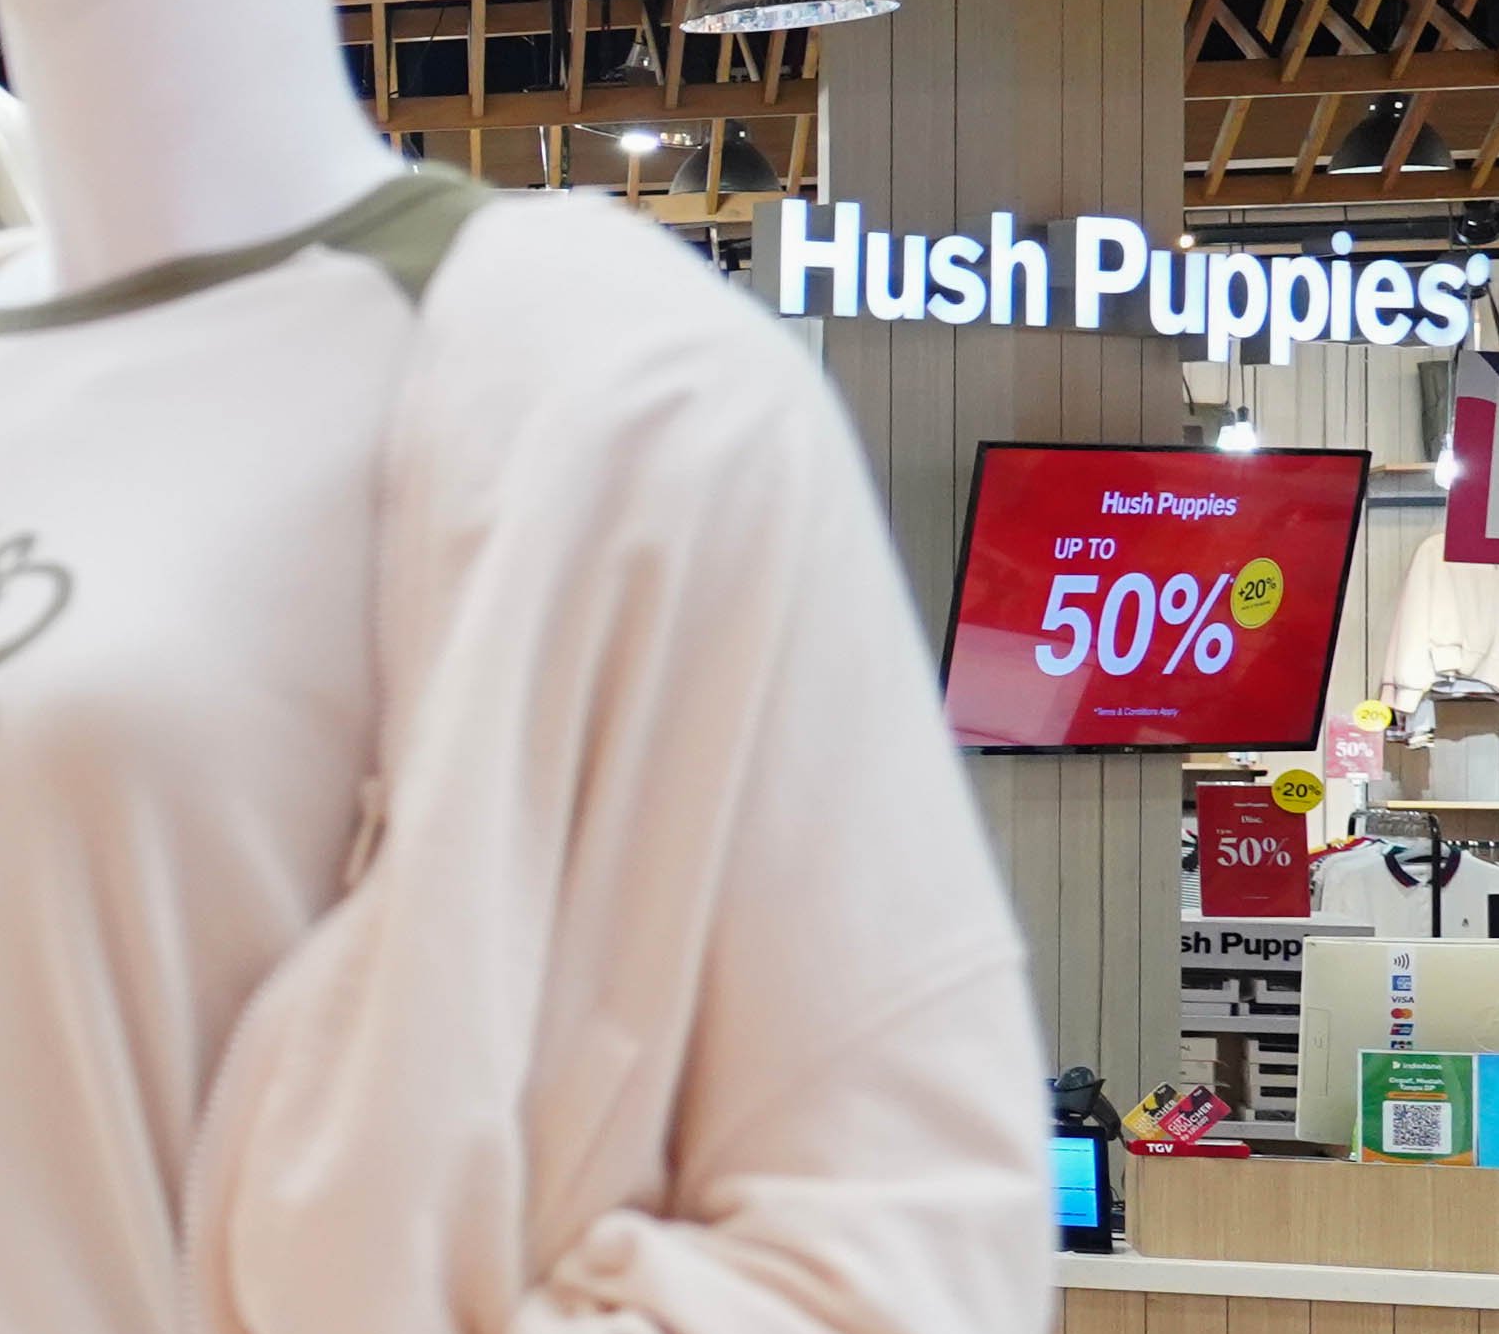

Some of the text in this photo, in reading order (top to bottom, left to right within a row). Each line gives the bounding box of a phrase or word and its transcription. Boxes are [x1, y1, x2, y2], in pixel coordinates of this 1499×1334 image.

[778, 198, 1470, 366] Hush Puppies
[1102, 492, 1237, 521] Hush Puppies
[1054, 537, 1116, 560] UP TO
[1238, 577, 1277, 601] +20%
[1034, 572, 1234, 677] 50%
[1217, 836, 1292, 868] 50%
[1391, 996, 1415, 1004] VISA
[1146, 1143, 1174, 1154] TGV
